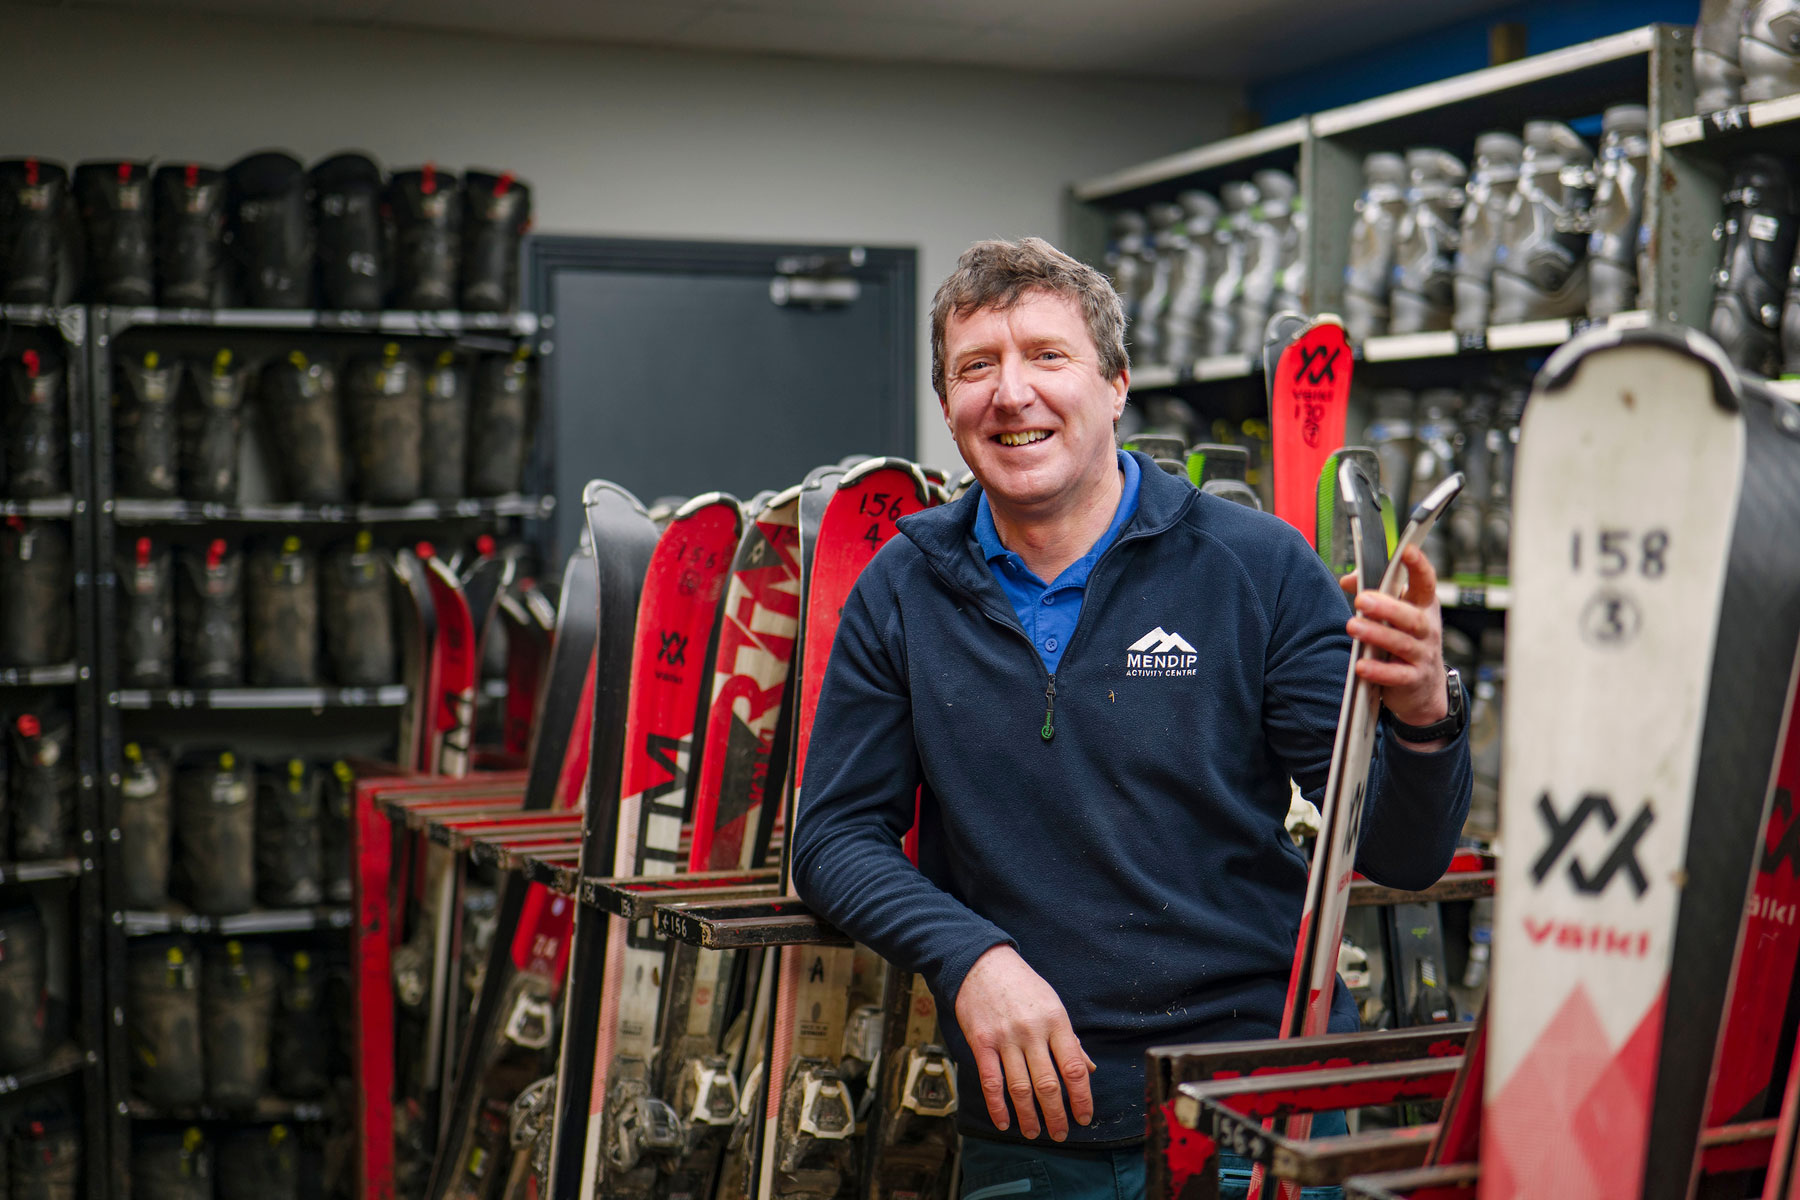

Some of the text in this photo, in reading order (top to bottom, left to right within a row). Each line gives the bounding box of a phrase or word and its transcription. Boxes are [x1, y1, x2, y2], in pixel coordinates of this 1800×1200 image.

[859, 492, 904, 521] 156
[864, 523, 883, 551] 4
[677, 542, 718, 569] 156
[1570, 529, 1670, 578] 158
[1126, 654, 1198, 669] MENDIP
[1126, 669, 1197, 677] ACTIVITY CENTRE
[671, 915, 688, 938] 156
